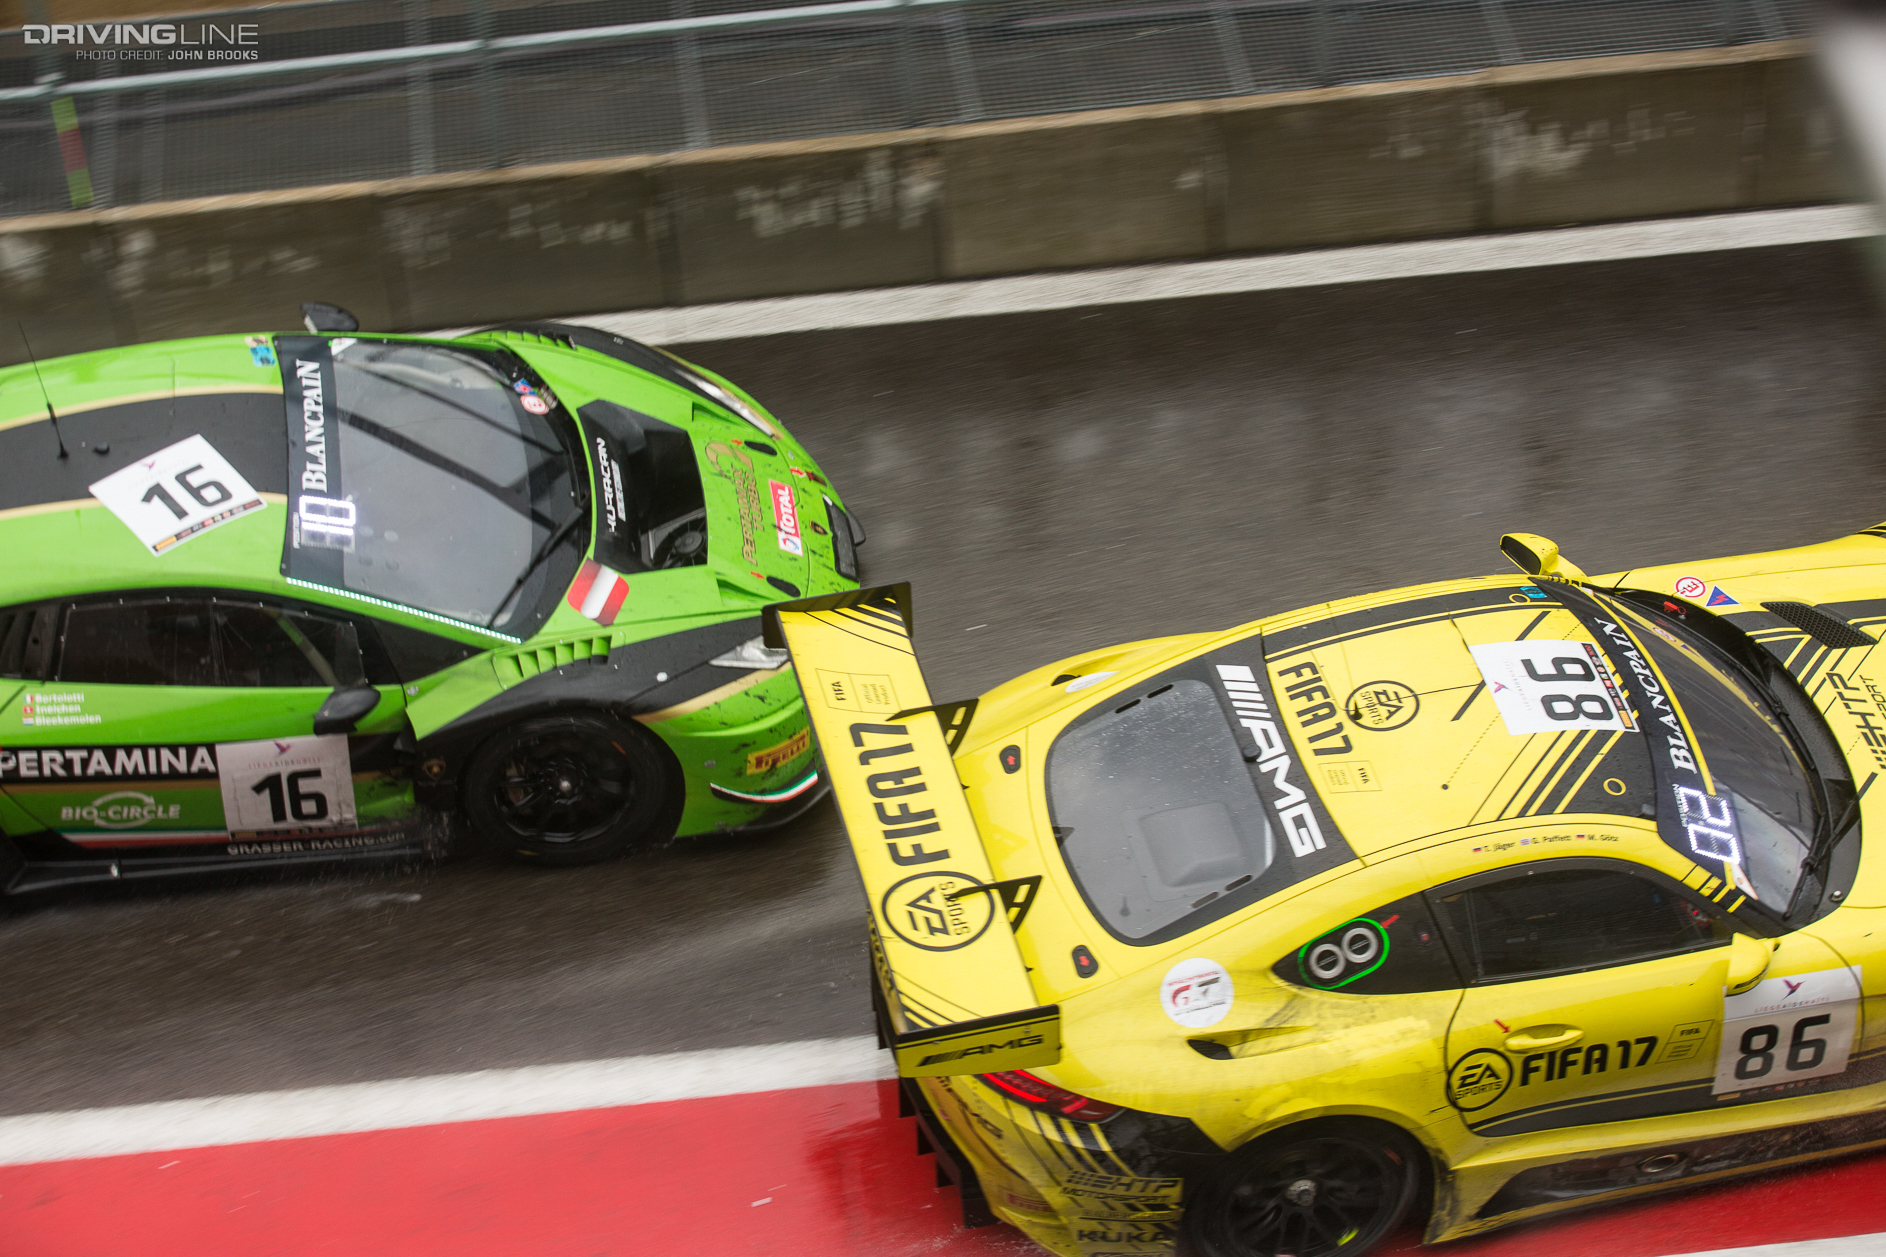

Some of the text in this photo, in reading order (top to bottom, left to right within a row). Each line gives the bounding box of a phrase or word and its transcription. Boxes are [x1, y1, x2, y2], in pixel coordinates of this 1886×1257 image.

[296, 358, 328, 493] BLANCPAIN
[141, 464, 233, 521] 16
[596, 437, 617, 534] HURACAN
[745, 471, 765, 532] TURBO
[777, 486, 796, 535] TOTAL
[299, 494, 356, 536] 10
[731, 462, 758, 566] PERTAMAX
[831, 681, 847, 701] FIFA
[1277, 661, 1353, 757] FIFA 17
[1360, 690, 1384, 726] SPORTS
[1373, 688, 1404, 721] EA
[1520, 656, 1614, 721] 86
[1594, 617, 1698, 774] BLANCPAIN
[0, 746, 217, 778] PERTAMINA
[849, 722, 915, 766] 17
[61, 804, 181, 821] BIO-CIRCLE
[251, 768, 328, 823] 16
[1239, 718, 1327, 858] AMG
[866, 766, 951, 867] FIFA
[904, 886, 950, 937] EA
[1520, 1036, 1659, 1087] FIFA 17
[1734, 1013, 1831, 1080] 86
[1455, 1080, 1503, 1100] SPORTS
[1457, 1063, 1502, 1089] EA
[1077, 1230, 1170, 1243] KUKA
